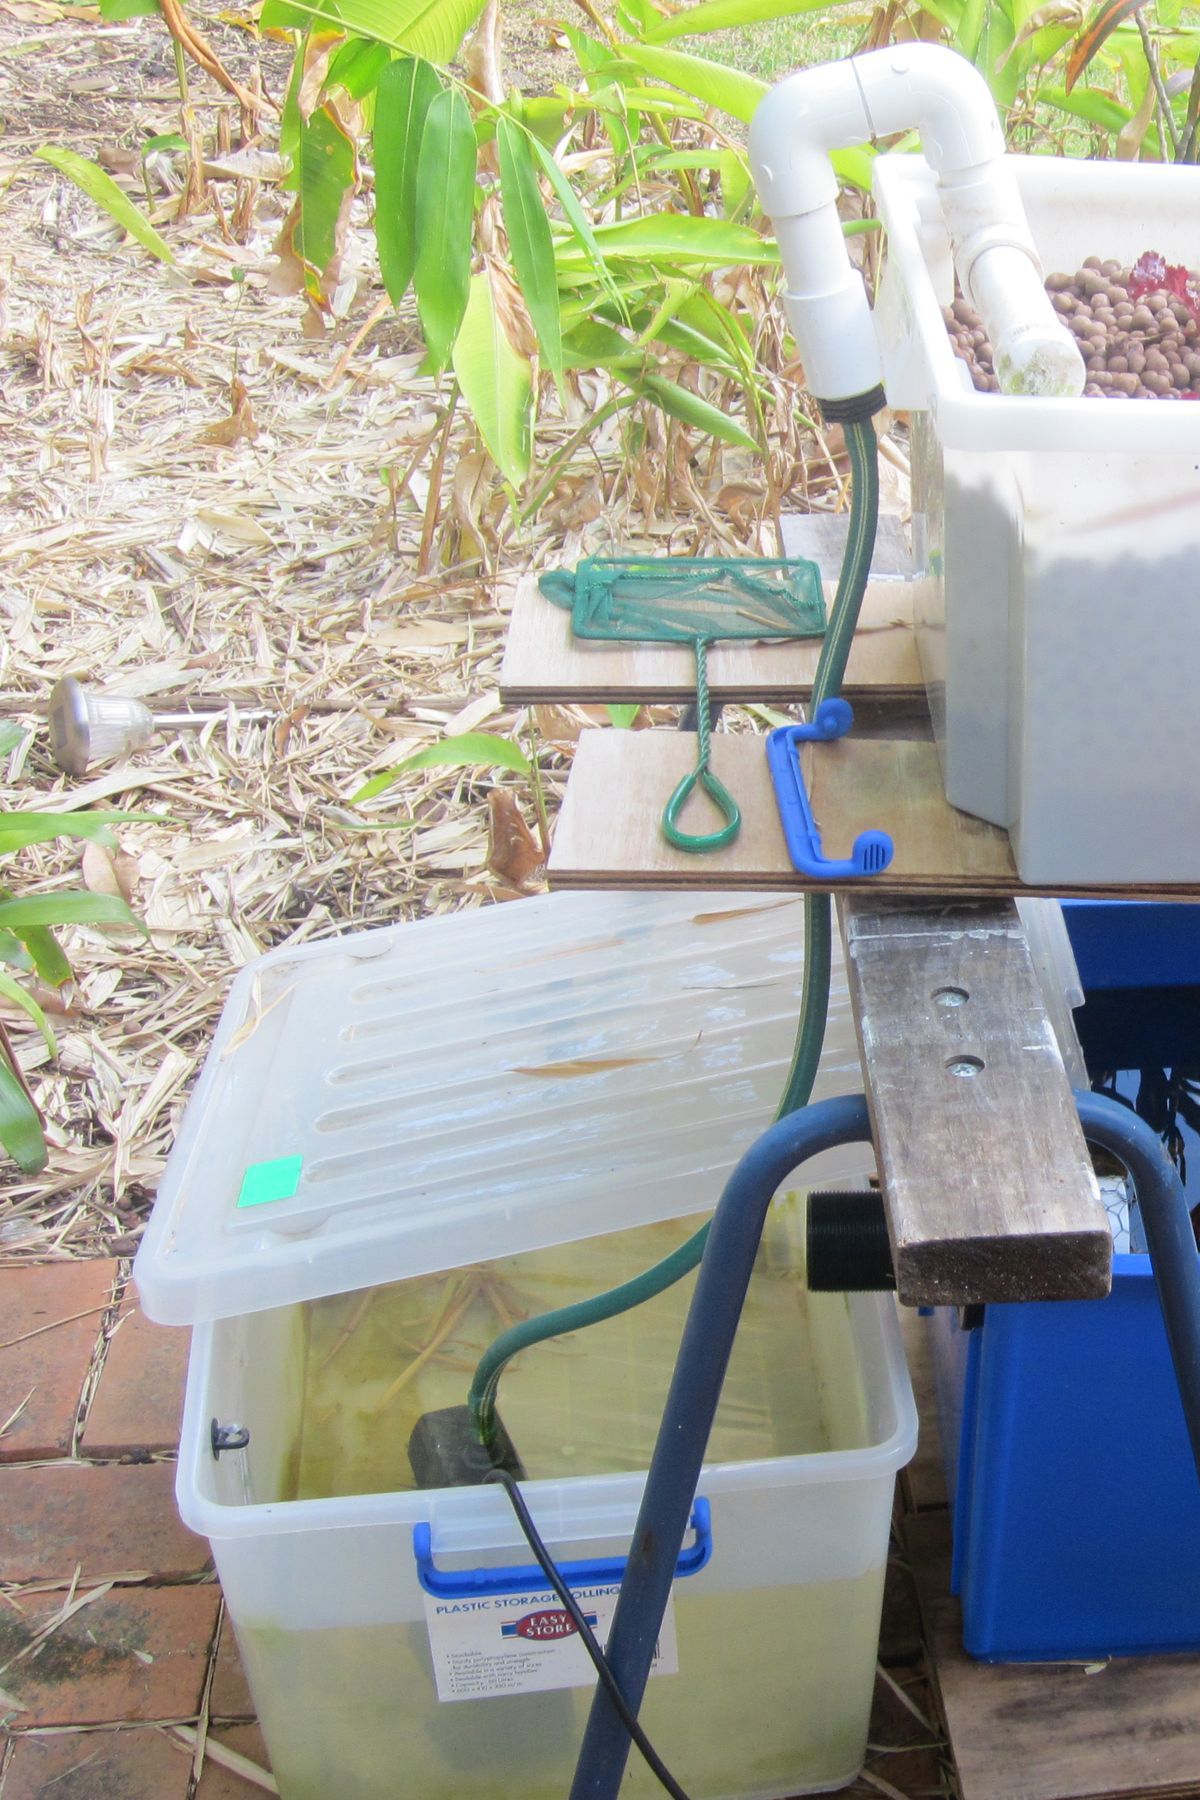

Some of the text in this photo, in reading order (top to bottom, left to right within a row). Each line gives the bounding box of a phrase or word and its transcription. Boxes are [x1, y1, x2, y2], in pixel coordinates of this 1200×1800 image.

[436, 1586, 620, 1614] PLASTIC STORAGE OLLING
[530, 1614, 568, 1626] EASY
[526, 1624, 574, 1636] STORE
